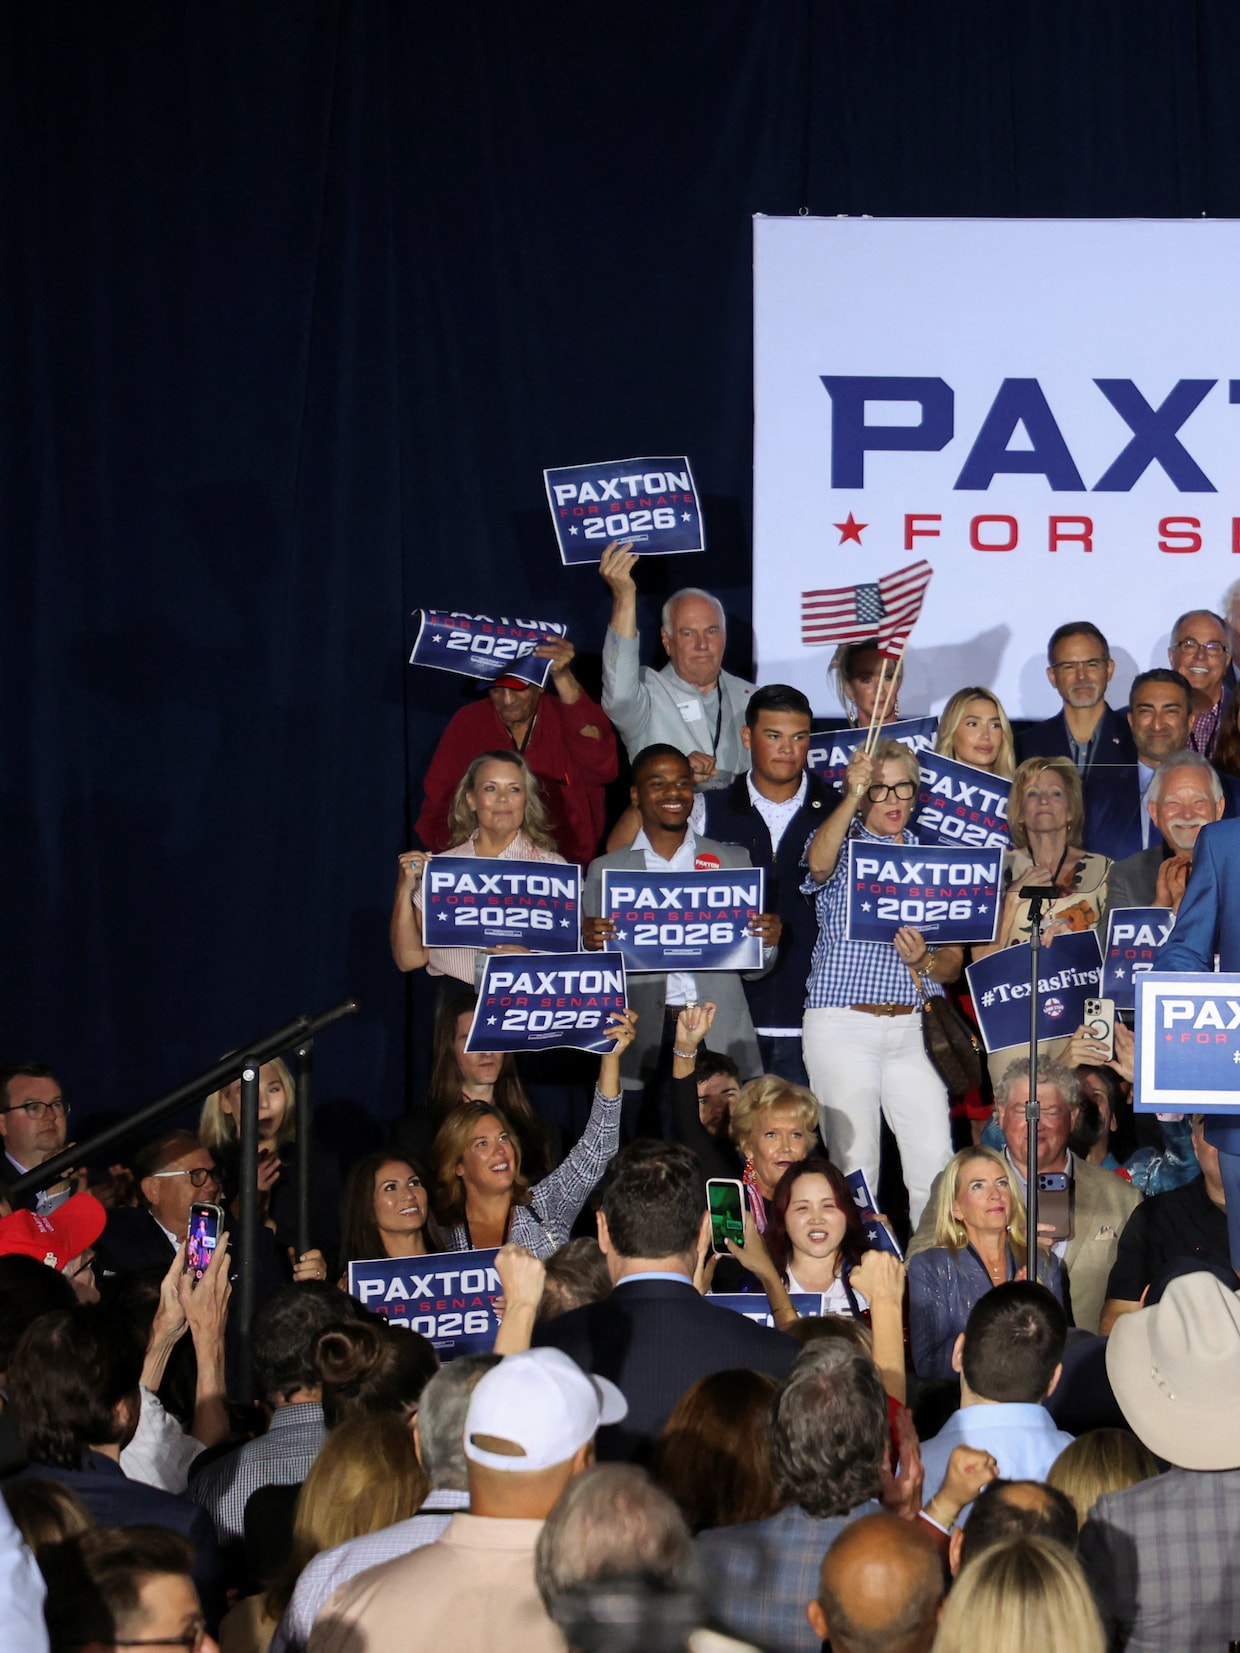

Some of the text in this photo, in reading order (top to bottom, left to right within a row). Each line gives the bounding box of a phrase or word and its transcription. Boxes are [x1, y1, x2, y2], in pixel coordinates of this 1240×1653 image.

[553, 472, 691, 505] PAXTON
[560, 494, 693, 518] FOR SENATE
[582, 507, 676, 539] 2026
[903, 513, 1095, 553] FOR
[430, 616, 550, 641] FOR SENAT
[446, 631, 537, 660] 2026
[919, 792, 946, 810] OR
[855, 857, 997, 886] PAXTON
[430, 872, 576, 899] PAXTON
[609, 884, 758, 909] PAXTON
[857, 883, 996, 897] FOR SENATE
[432, 895, 576, 911] FOR SENATE
[876, 898, 972, 922] 2026
[454, 907, 553, 930] 2026
[610, 909, 758, 922] FOR SENATE
[633, 922, 734, 946] 2026
[1111, 949, 1153, 959] FOR
[487, 970, 624, 995] PAXTON
[486, 996, 624, 1007] FOR SENATE
[501, 1009, 602, 1031] 2026
[1180, 1033, 1232, 1045] FOR
[376, 1295, 497, 1314] OR SENAT
